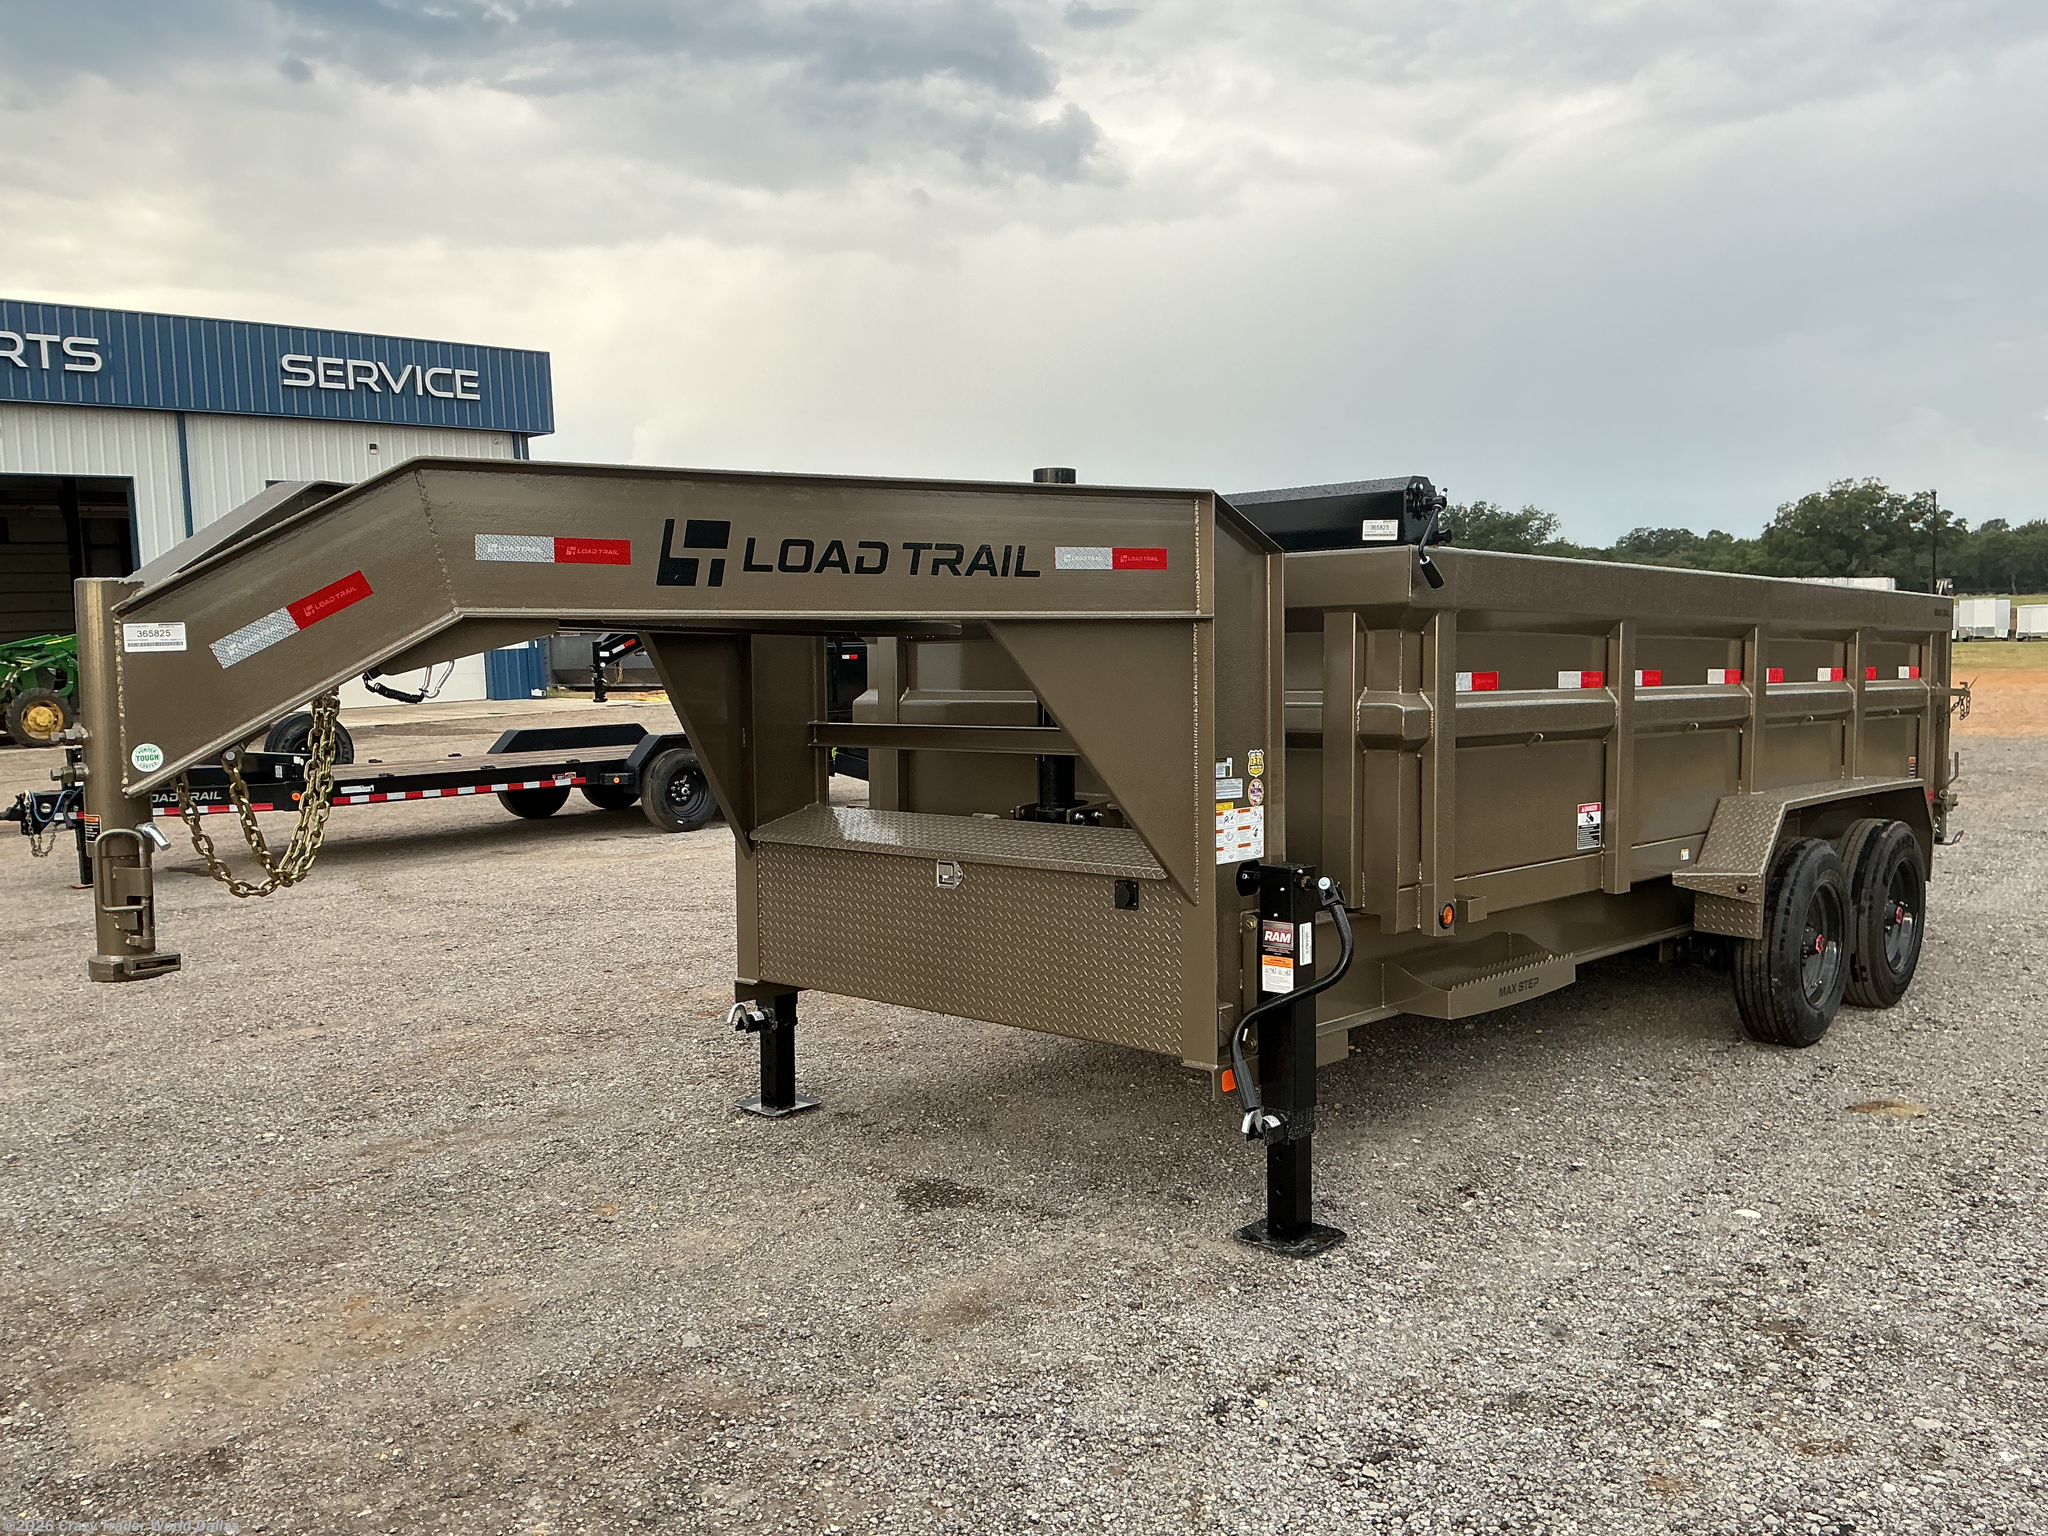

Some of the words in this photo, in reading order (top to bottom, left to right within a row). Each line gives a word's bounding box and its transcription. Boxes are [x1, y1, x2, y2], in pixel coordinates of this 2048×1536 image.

[281, 353, 481, 400] SERVICE
[742, 536, 890, 575] LOAD
[902, 541, 1041, 578] TRAIL
[315, 596, 336, 610] LOAD
[335, 586, 357, 599] TRAIL
[136, 629, 171, 638] 365825
[135, 754, 159, 762] TOUGH
[152, 793, 179, 803] OAD
[190, 790, 222, 801] RAIL
[1264, 930, 1291, 944] RAM
[1499, 983, 1517, 997] MAX
[1518, 977, 1539, 992] STEP
